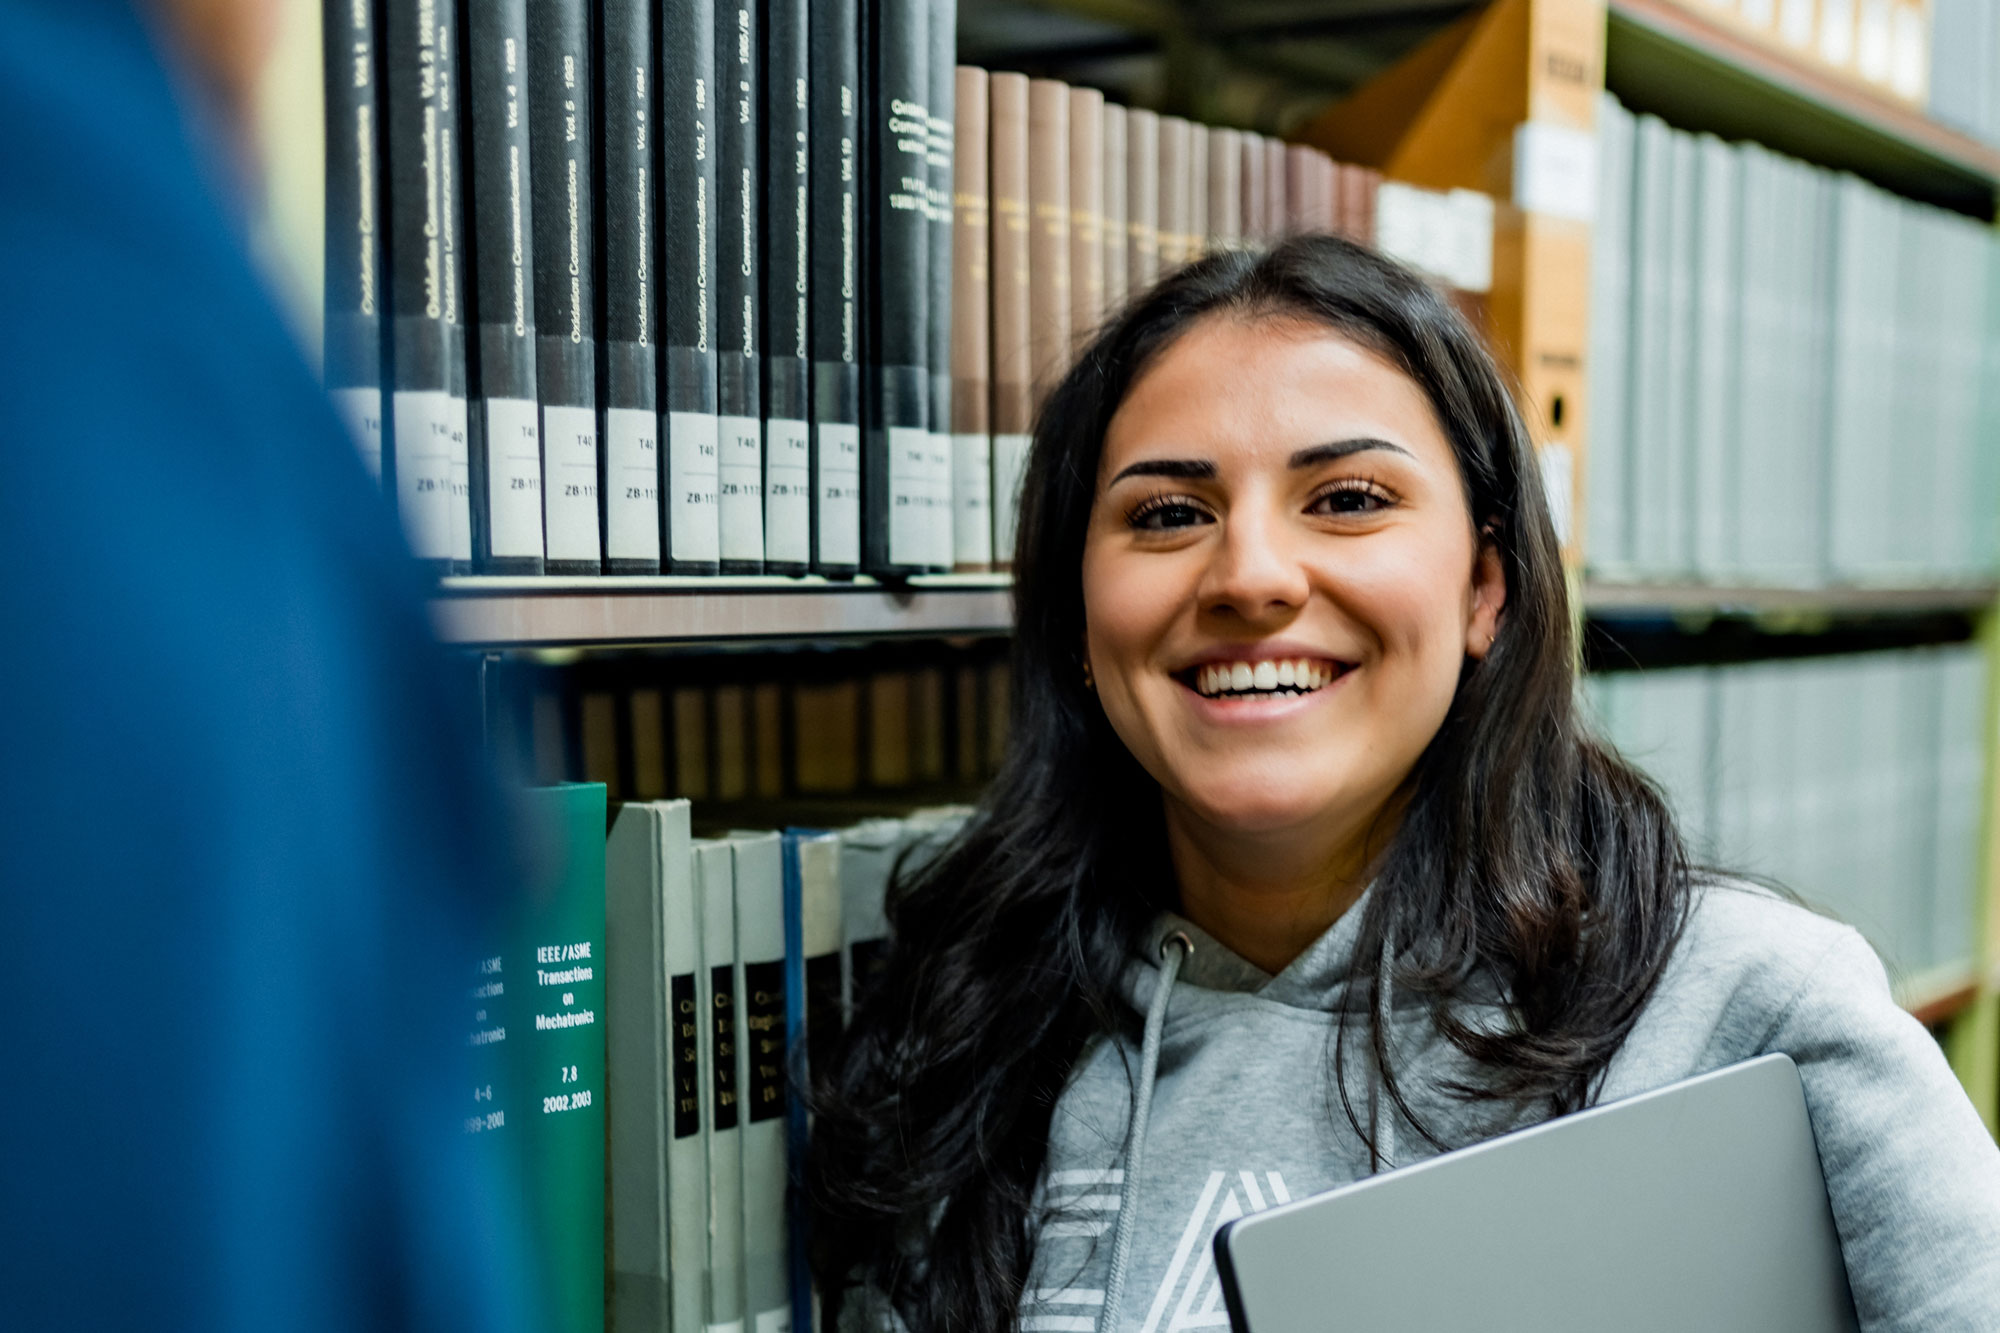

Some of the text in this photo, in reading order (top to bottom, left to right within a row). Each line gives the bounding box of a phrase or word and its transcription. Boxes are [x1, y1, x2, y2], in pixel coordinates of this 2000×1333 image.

[565, 113, 577, 142] Vol.
[636, 123, 646, 151] Vol.
[739, 95, 751, 124] Vol.
[422, 105, 438, 238] Communications
[696, 131, 706, 161] Vol.
[509, 145, 520, 267] Communications
[567, 158, 578, 276] Communications
[637, 167, 647, 282] Communications
[696, 176, 706, 289] Communications
[740, 167, 752, 277] Communications
[796, 185, 807, 294] Communications
[841, 191, 853, 299] Communications
[425, 237, 441, 320] Oxidation
[514, 266, 525, 337] Oxidation
[570, 276, 582, 344] Oxidation
[638, 281, 648, 348] Oxidation
[697, 288, 707, 353] Oxidation
[742, 294, 754, 359] Oxidation
[796, 296, 807, 359] Oxidation
[842, 301, 854, 363] Oxidation
[576, 434, 593, 447] T40
[638, 438, 654, 450] T40
[698, 444, 714, 456] T40
[737, 436, 756, 448] T40
[537, 941, 592, 964] IEEE/ASME
[537, 965, 593, 986] Transactions
[476, 1009, 487, 1022] on
[535, 1008, 595, 1031] Mechatronics
[562, 992, 574, 1006] on
[474, 1084, 492, 1103] 4-6
